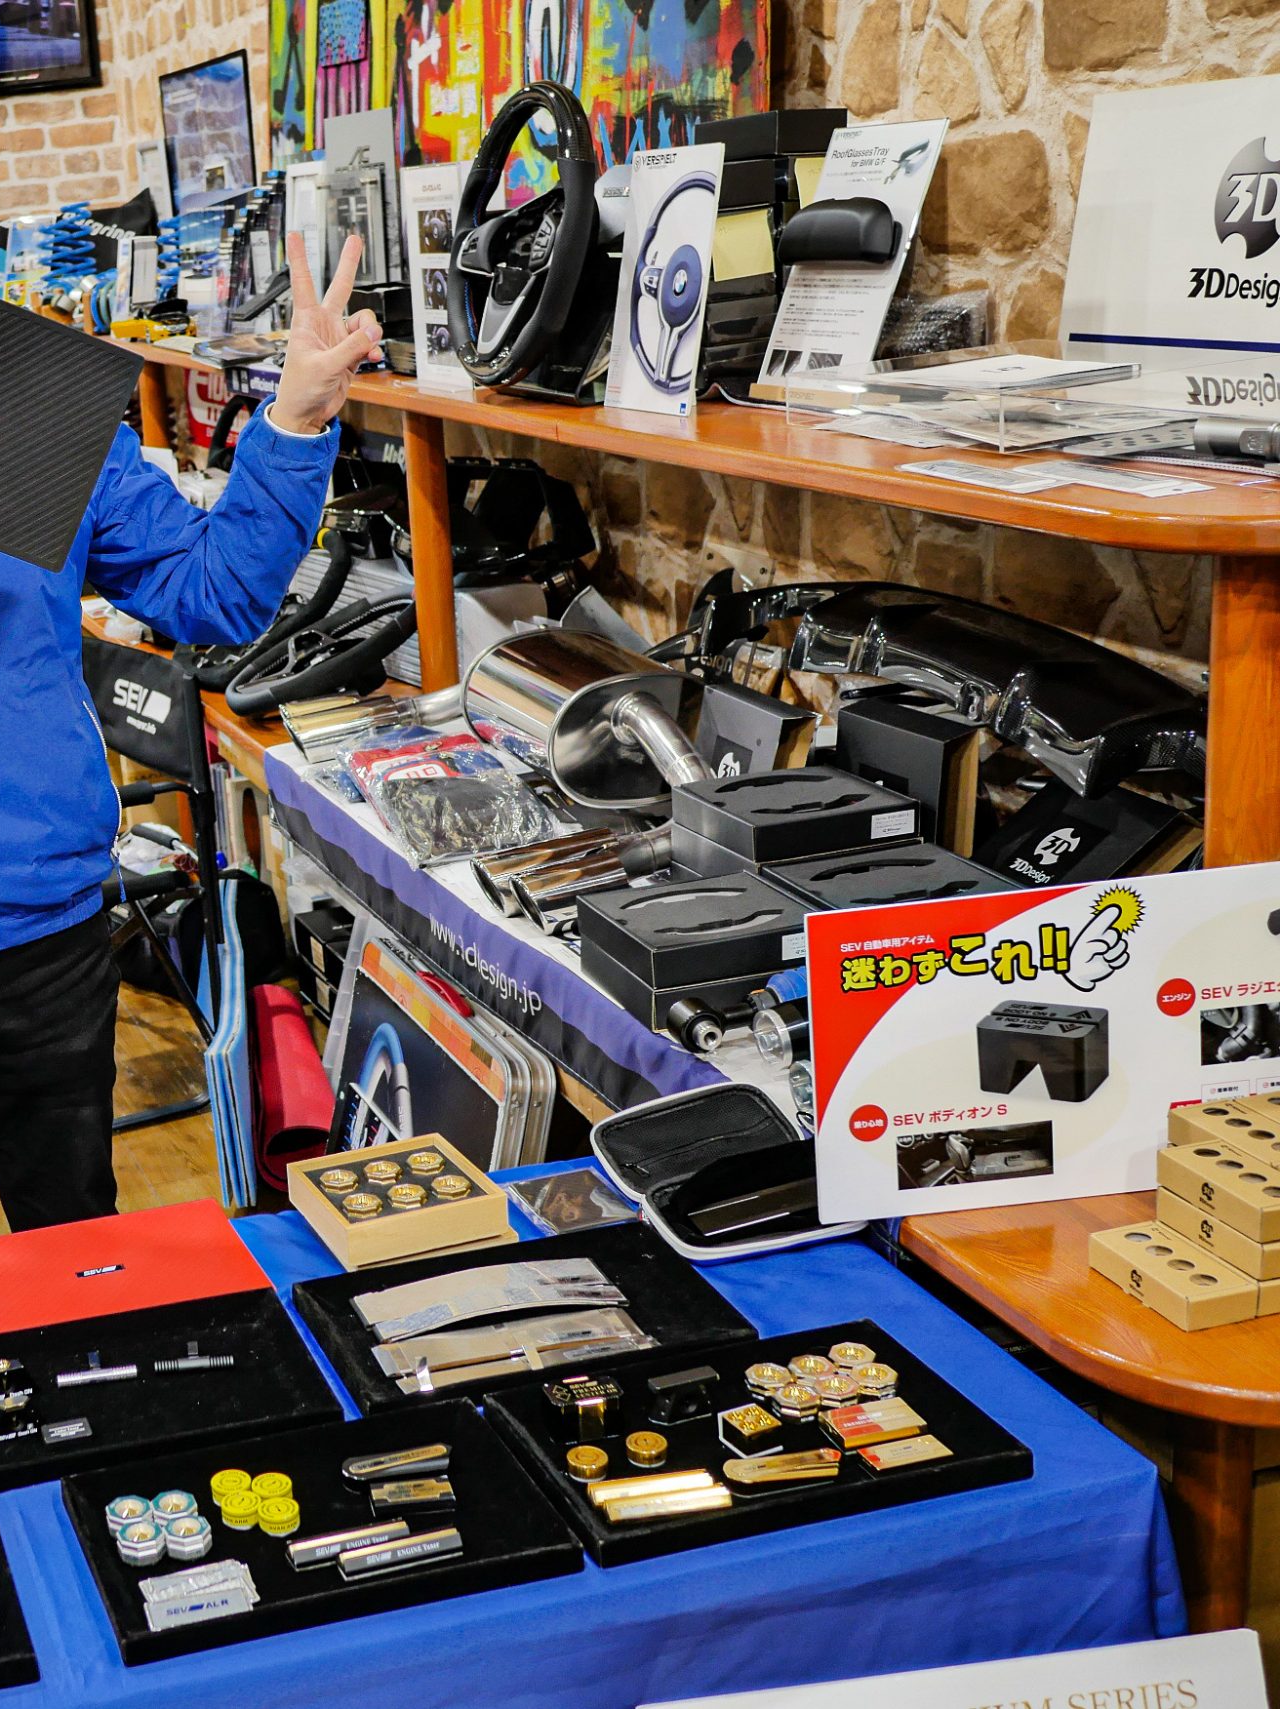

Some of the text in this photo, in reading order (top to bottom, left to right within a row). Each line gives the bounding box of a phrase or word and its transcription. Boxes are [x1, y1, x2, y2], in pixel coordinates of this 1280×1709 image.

[1187, 267, 1280, 308] 3DDesig
[113, 678, 149, 714] SEV
[1009, 857, 1051, 884] 3DDesign
[840, 934, 935, 952] SEV 自動車用アイテム
[841, 923, 1070, 993] 迷わずこれ!!
[1161, 993, 1192, 1003] エンジン
[1201, 986, 1233, 1000] SEV
[893, 1104, 1008, 1126] SEV ボディオン S
[346, 1538, 371, 1550] ENGINE
[397, 1547, 422, 1558] ENGINE
[206, 1601, 220, 1610] AL
